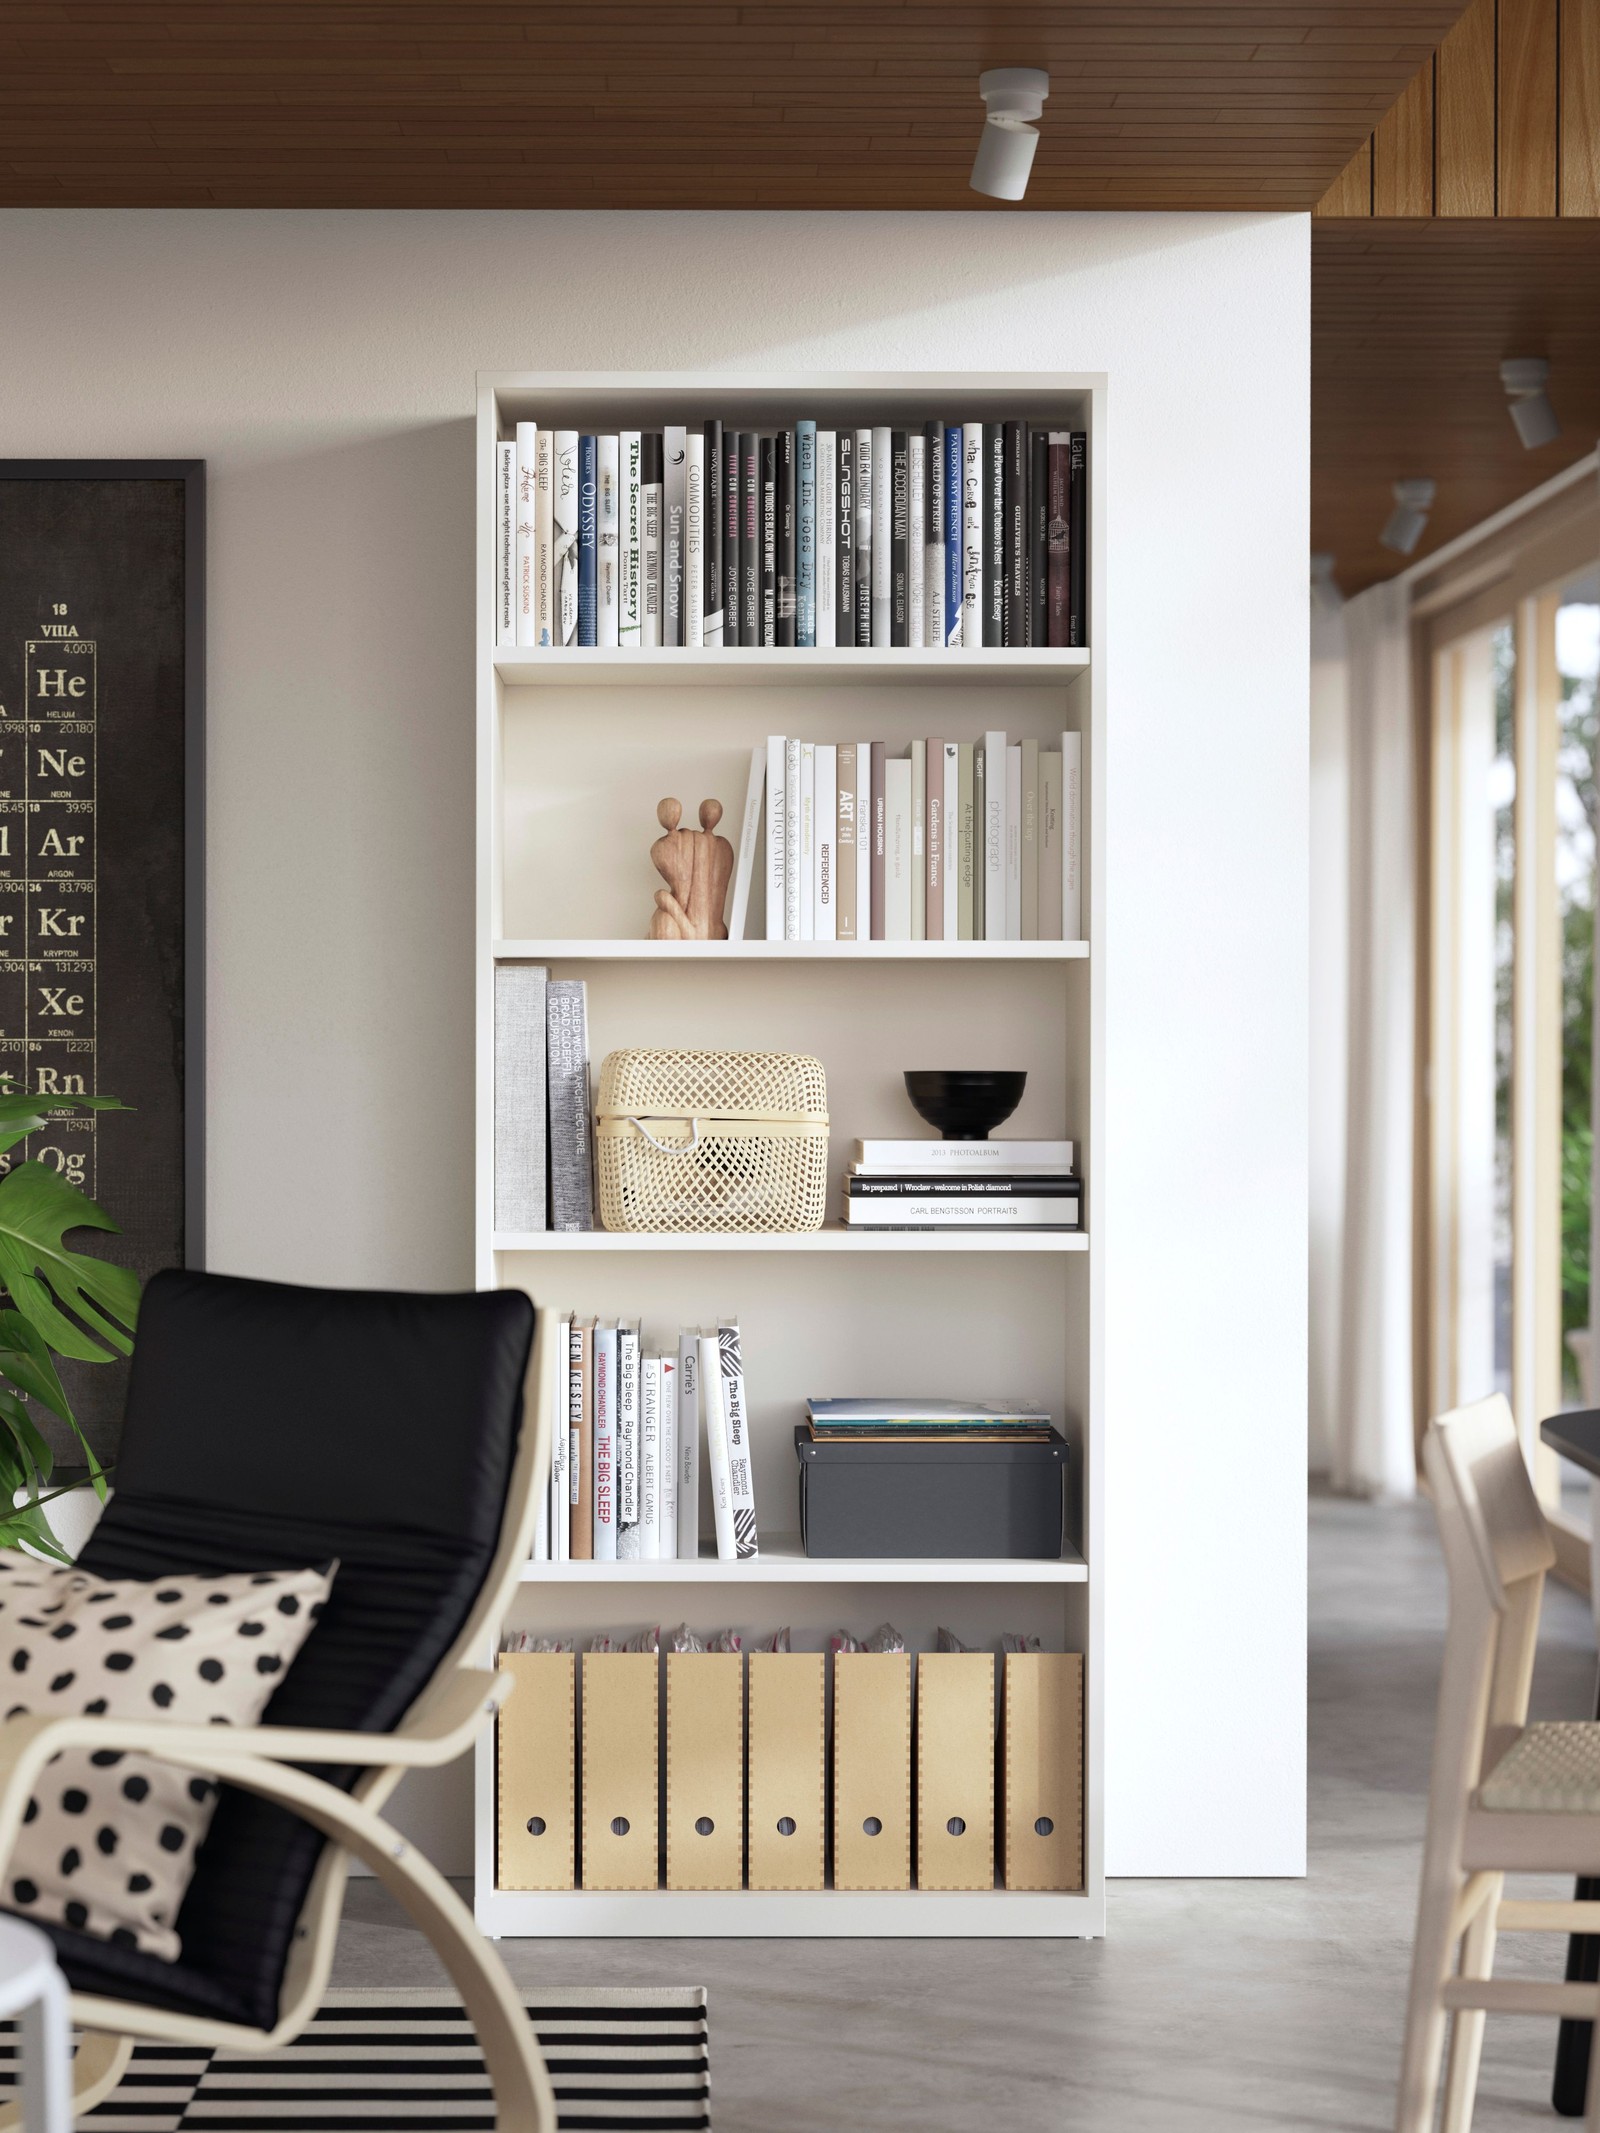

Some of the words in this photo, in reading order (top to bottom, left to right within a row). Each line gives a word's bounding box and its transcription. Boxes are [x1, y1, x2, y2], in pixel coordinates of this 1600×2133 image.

[802, 433, 813, 469] When
[994, 438, 1003, 453] One
[630, 441, 639, 479] The
[895, 450, 906, 468] THE
[994, 455, 1003, 475] Flew
[765, 482, 774, 491] NO
[802, 480, 813, 507] Ink
[842, 439, 850, 549] SLINGSHOT
[895, 468, 906, 517] ACCORDIAN
[933, 484, 940, 497] OF
[951, 480, 957, 496] MY
[994, 476, 1003, 496] Over
[647, 492, 657, 505] THE
[689, 465, 700, 553] COMMODITIES
[765, 492, 774, 512] TODOS
[994, 498, 1003, 510] the
[581, 482, 596, 548] ODYSSEY
[630, 483, 639, 543] Secret
[647, 507, 657, 519] BIG
[670, 505, 682, 534] Sun
[765, 513, 774, 521] ES
[647, 520, 657, 538] SLEEP
[765, 522, 774, 542] BLACK
[802, 516, 813, 552] Goes
[895, 520, 906, 539] MAN
[994, 512, 1003, 545] Cuckoo's
[670, 540, 682, 568] and
[765, 543, 774, 551] OR
[994, 546, 1003, 564] Nest
[647, 551, 657, 580] RAYMOND
[765, 553, 774, 572] WHITE
[842, 555, 850, 576] TOBIAS
[627, 549, 639, 620] History
[799, 562, 813, 589] Dry
[647, 583, 657, 614] CHANDLER
[670, 574, 681, 618] Snow
[842, 577, 850, 612] KLAUSMANN
[932, 591, 940, 606] A.J.
[994, 580, 1003, 596] Ken
[1054, 586, 1062, 600] Fairy
[52, 604, 67, 615] 18
[860, 584, 869, 619] JOSEPH
[896, 598, 904, 623] ELIASON
[992, 598, 1003, 621] Kesey
[41, 625, 79, 637] VIIIA
[860, 622, 870, 642] HITT
[932, 609, 940, 641] STRIFE
[29, 644, 35, 653] 2
[63, 643, 95, 654] 4.003
[37, 670, 86, 697] He
[29, 724, 41, 733] 10
[60, 723, 95, 733] 20.180
[37, 749, 85, 777] Ne
[1069, 768, 1077, 789] World
[29, 804, 40, 812] 18
[66, 803, 94, 813] 39.95
[840, 790, 853, 821] ART
[965, 804, 973, 813] At
[1027, 791, 1035, 811] Over
[859, 800, 868, 833] Franska
[931, 799, 940, 839] Gardens
[965, 816, 973, 831] the
[1026, 814, 1034, 825] the
[38, 829, 84, 856] Ar
[772, 789, 784, 888] ANTIQUAIRES
[859, 836, 867, 850] 101
[988, 801, 1002, 872] photograph
[1025, 827, 1033, 840] top
[1068, 832, 1077, 859] through
[931, 842, 939, 851] in
[963, 832, 972, 863] cutting
[821, 844, 829, 904] REFERENCED
[931, 854, 939, 886] France
[963, 865, 973, 887] edge
[29, 883, 42, 892] 36
[59, 882, 95, 893] 83.798
[38, 909, 85, 936] Kr
[29, 963, 41, 971] 54
[56, 962, 95, 973] 131.293
[38, 988, 83, 1015] Xe
[560, 996, 571, 1027] BRAD
[570, 996, 582, 1032] ALLIED
[48, 1029, 74, 1037] XENON
[548, 996, 560, 1067] OCCUPATION
[28, 1042, 42, 1051] 86
[67, 1040, 95, 1054] [222]
[561, 1027, 573, 1080] CLOEPFIL
[573, 1033, 583, 1074] WORKS
[36, 1068, 86, 1094] Rn
[573, 1074, 586, 1156] ARCHITECTURE
[871, 1184, 898, 1192] prepared
[978, 1207, 1018, 1215] PORTRAITS
[570, 1334, 581, 1360] KEN
[625, 1342, 634, 1360] The
[598, 1353, 606, 1388] RAYMOND
[623, 1364, 634, 1379] Big
[685, 1356, 695, 1394] Carrie's
[570, 1372, 582, 1419] KESEY
[623, 1382, 634, 1410] Sleep
[729, 1380, 738, 1399] The
[597, 1389, 606, 1428] CHANDLER
[646, 1372, 656, 1441] STRANGER
[729, 1401, 740, 1418] Big
[732, 1420, 741, 1445] Sleep
[598, 1436, 610, 1458] THE
[623, 1421, 634, 1469] Raymond
[598, 1462, 610, 1482] BIG
[646, 1453, 654, 1489] ALBERT
[730, 1459, 742, 1495] Chandler
[736, 1458, 749, 1495] Raymond
[598, 1486, 610, 1523] SLEEP
[625, 1472, 634, 1516] Chandler
